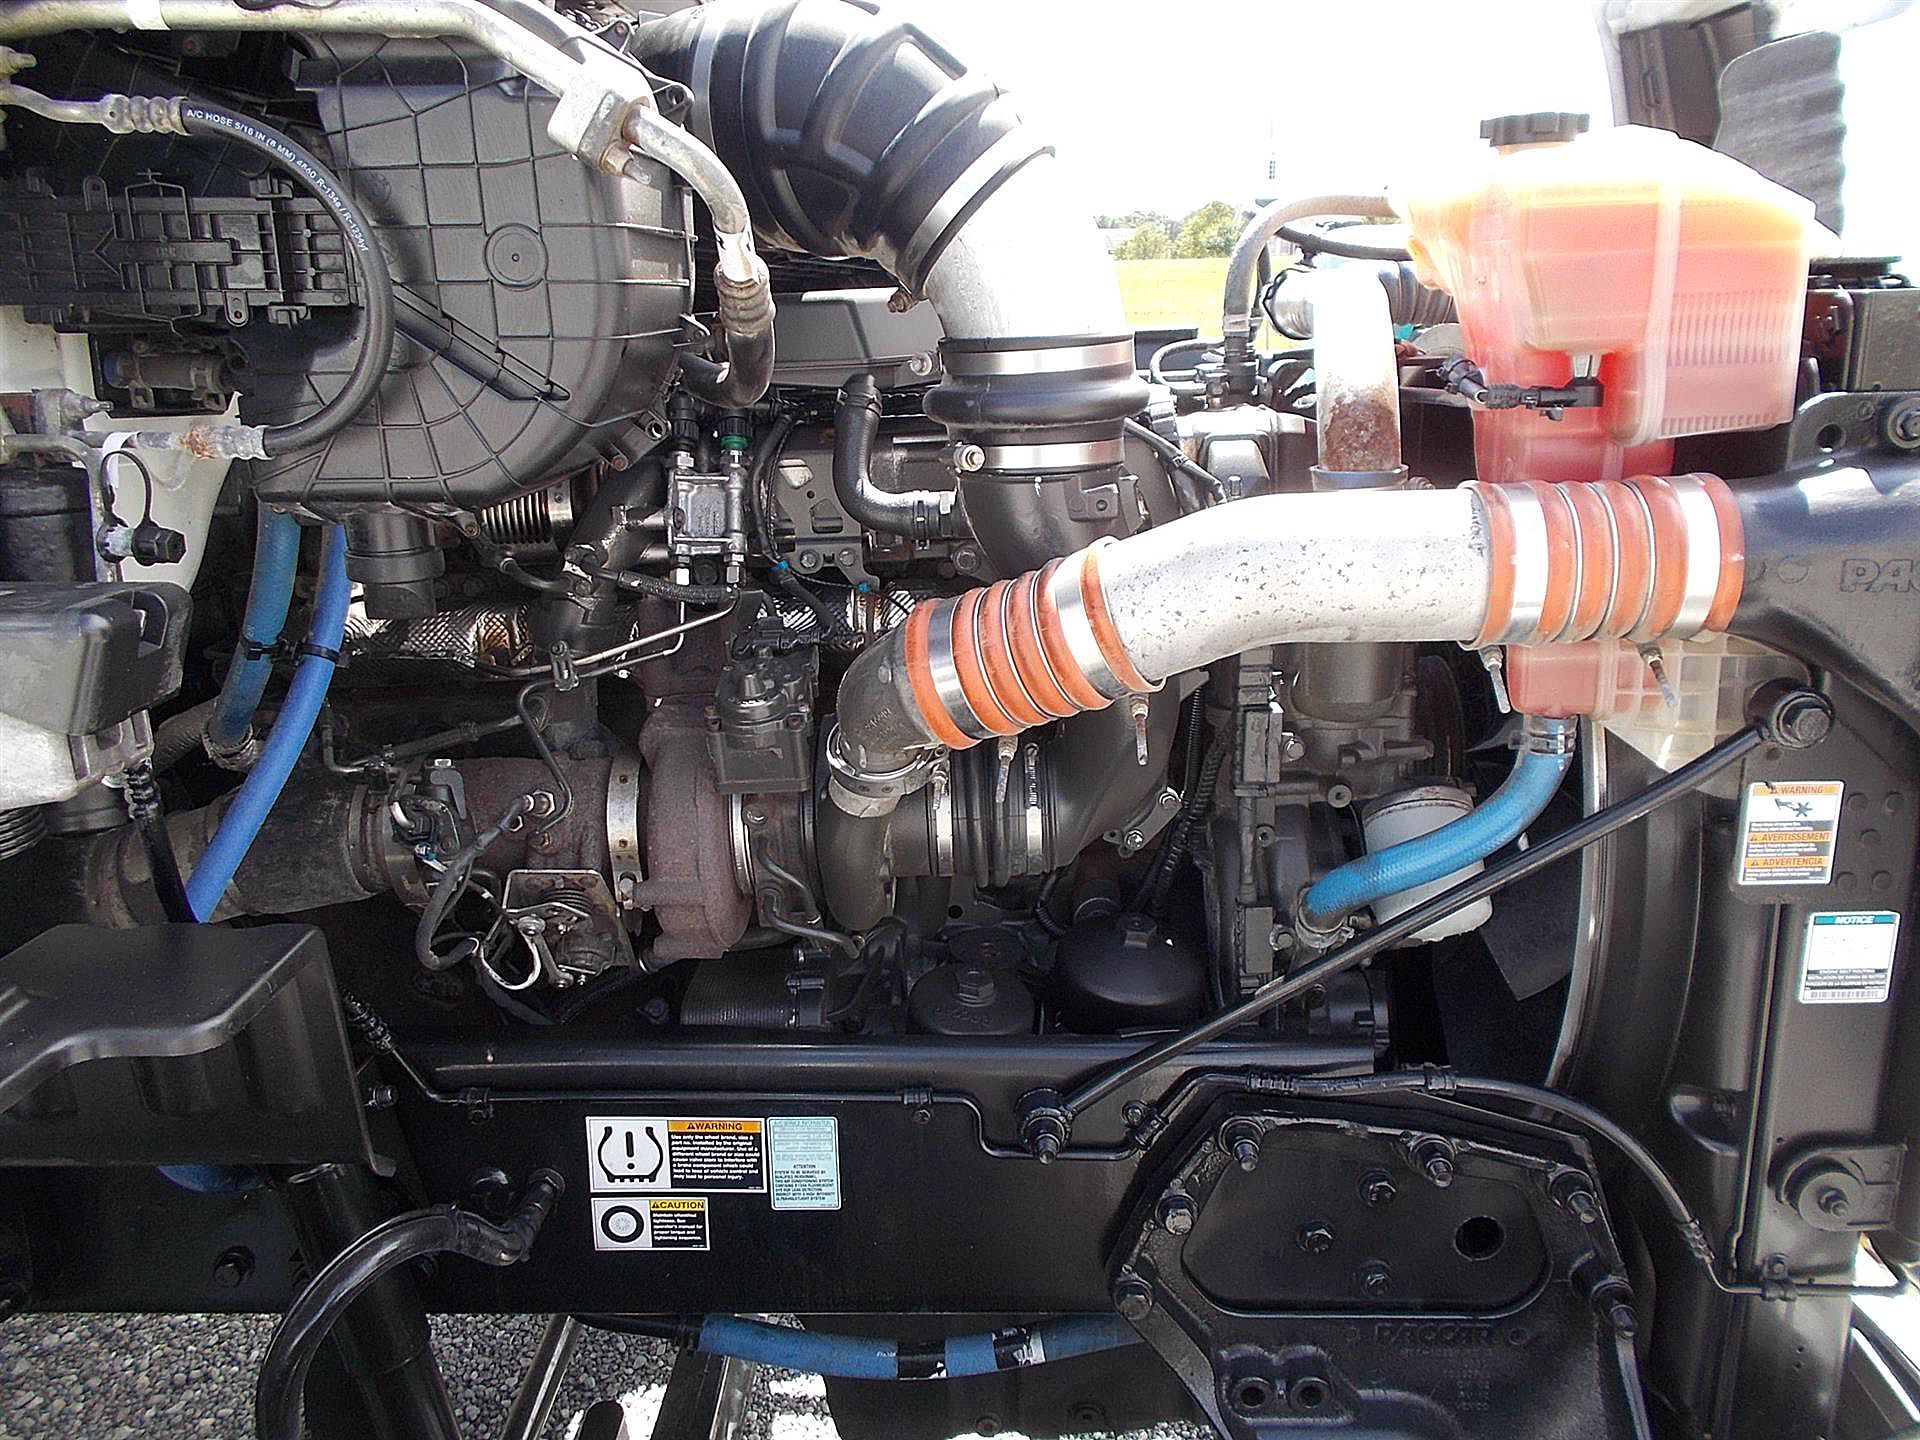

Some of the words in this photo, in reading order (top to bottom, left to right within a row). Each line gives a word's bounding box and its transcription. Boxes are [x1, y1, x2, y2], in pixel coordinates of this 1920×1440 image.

[187, 109, 204, 119] A/C
[206, 112, 233, 127] HOSE
[255, 130, 267, 142] IN
[276, 144, 297, 162] MM)
[316, 178, 341, 208] R-134a
[343, 211, 369, 252] R-1234yf
[1840, 558, 1920, 592] PA
[1761, 832, 1830, 841] AVERTISSEMENT
[1762, 858, 1822, 866] ADVERTENCIA
[1834, 916, 1875, 924] NOTICE
